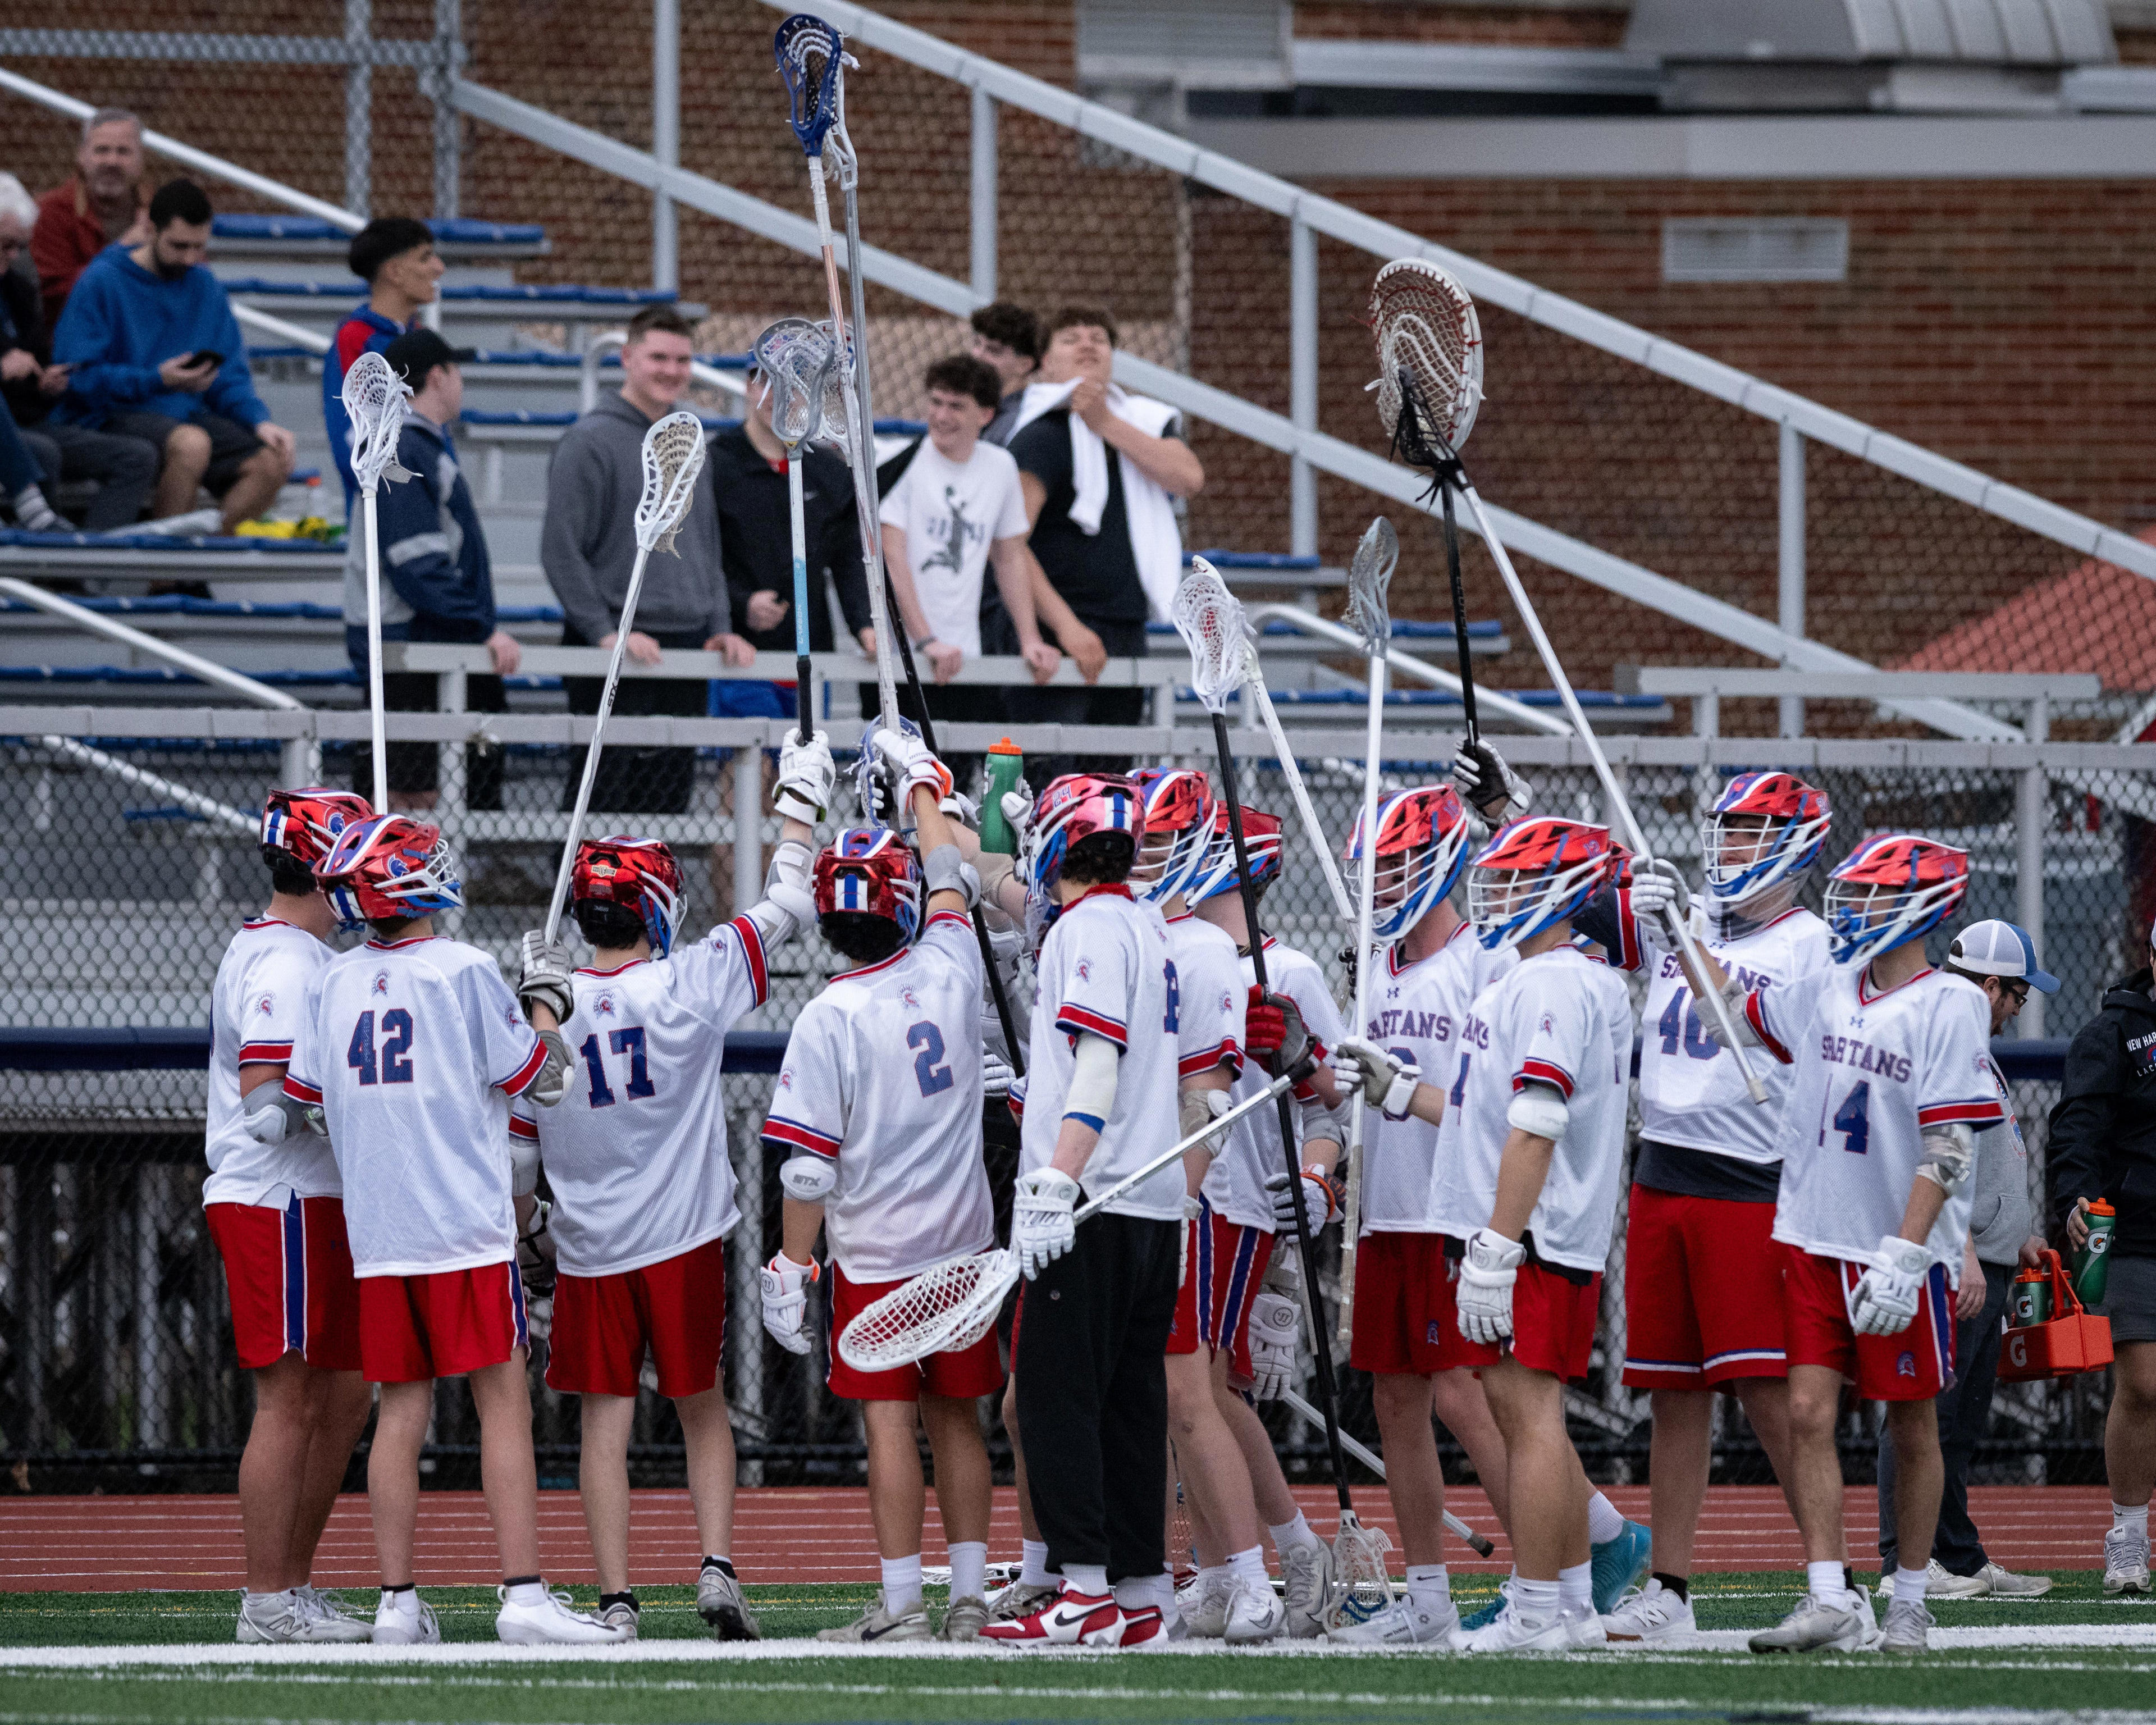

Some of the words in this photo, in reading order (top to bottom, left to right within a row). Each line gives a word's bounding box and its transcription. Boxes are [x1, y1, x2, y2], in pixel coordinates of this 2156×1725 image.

[1053, 783, 1073, 809] 24
[347, 1008, 414, 1087] 42
[2126, 1038, 2142, 1053] NEW
[579, 1026, 656, 1109] 17
[906, 1020, 954, 1098] 2
[2137, 1062, 2156, 1077] LAC
[792, 1174, 821, 1187] STX
[2088, 1232, 2108, 1254] G
[2016, 1294, 2034, 1318] G
[2009, 1335, 2027, 1368] G
